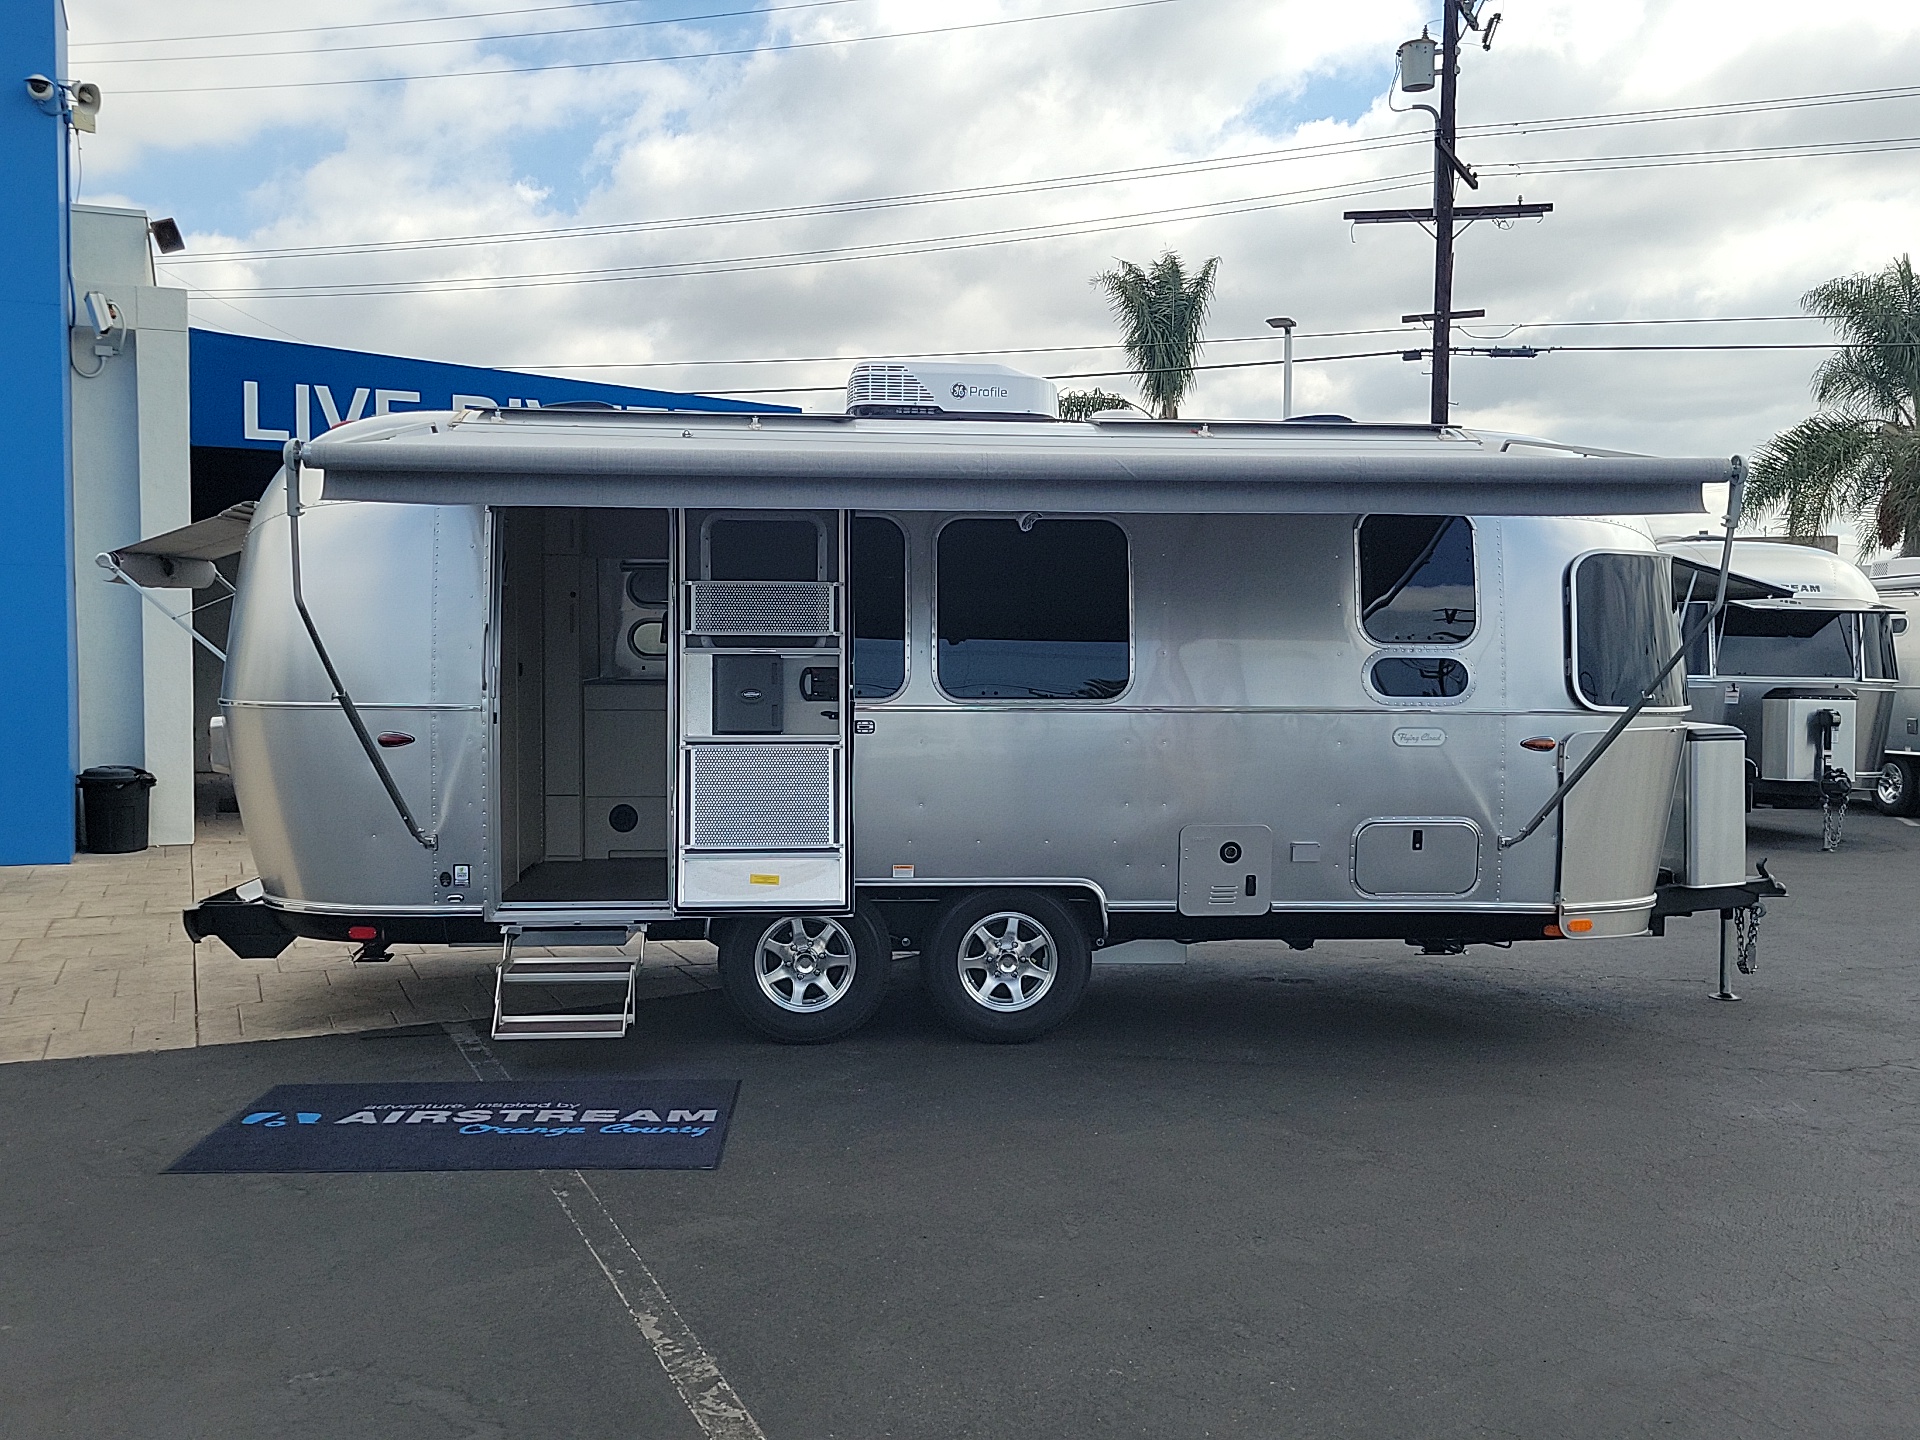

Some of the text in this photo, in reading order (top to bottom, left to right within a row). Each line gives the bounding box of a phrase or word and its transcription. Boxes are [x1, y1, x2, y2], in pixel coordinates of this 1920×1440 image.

[969, 386, 1008, 398] Profile
[333, 1109, 719, 1125] AIRSTREAM
[459, 1123, 712, 1138] Orange County
